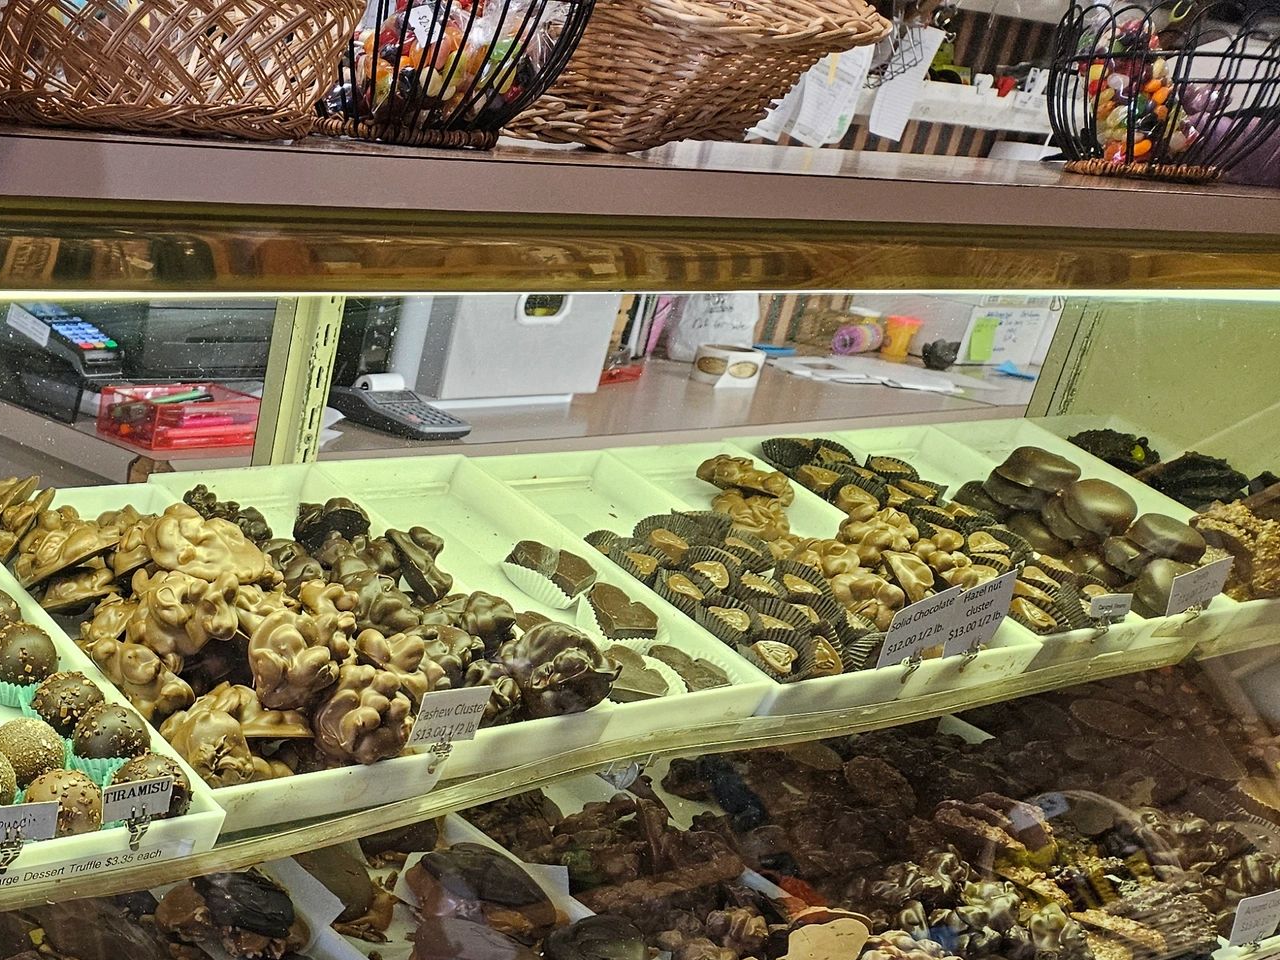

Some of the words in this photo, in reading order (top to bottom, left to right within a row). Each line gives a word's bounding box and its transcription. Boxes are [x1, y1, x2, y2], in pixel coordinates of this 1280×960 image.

[890, 615, 913, 632] Solid
[913, 597, 955, 622] Chocolate
[948, 620, 977, 641] $13.00
[976, 614, 992, 627] 1/2
[886, 635, 917, 656] $12.00
[917, 627, 933, 642] 1/2
[933, 623, 944, 633] lb.
[418, 706, 453, 720] Cashew
[454, 702, 487, 716] Cluster
[414, 726, 446, 742] $13.00
[104, 781, 170, 803] TIRAMISU
[23, 866, 65, 881] Dessert
[69, 860, 102, 873] Truffle
[105, 853, 134, 867] $3.35
[136, 849, 162, 861] each
